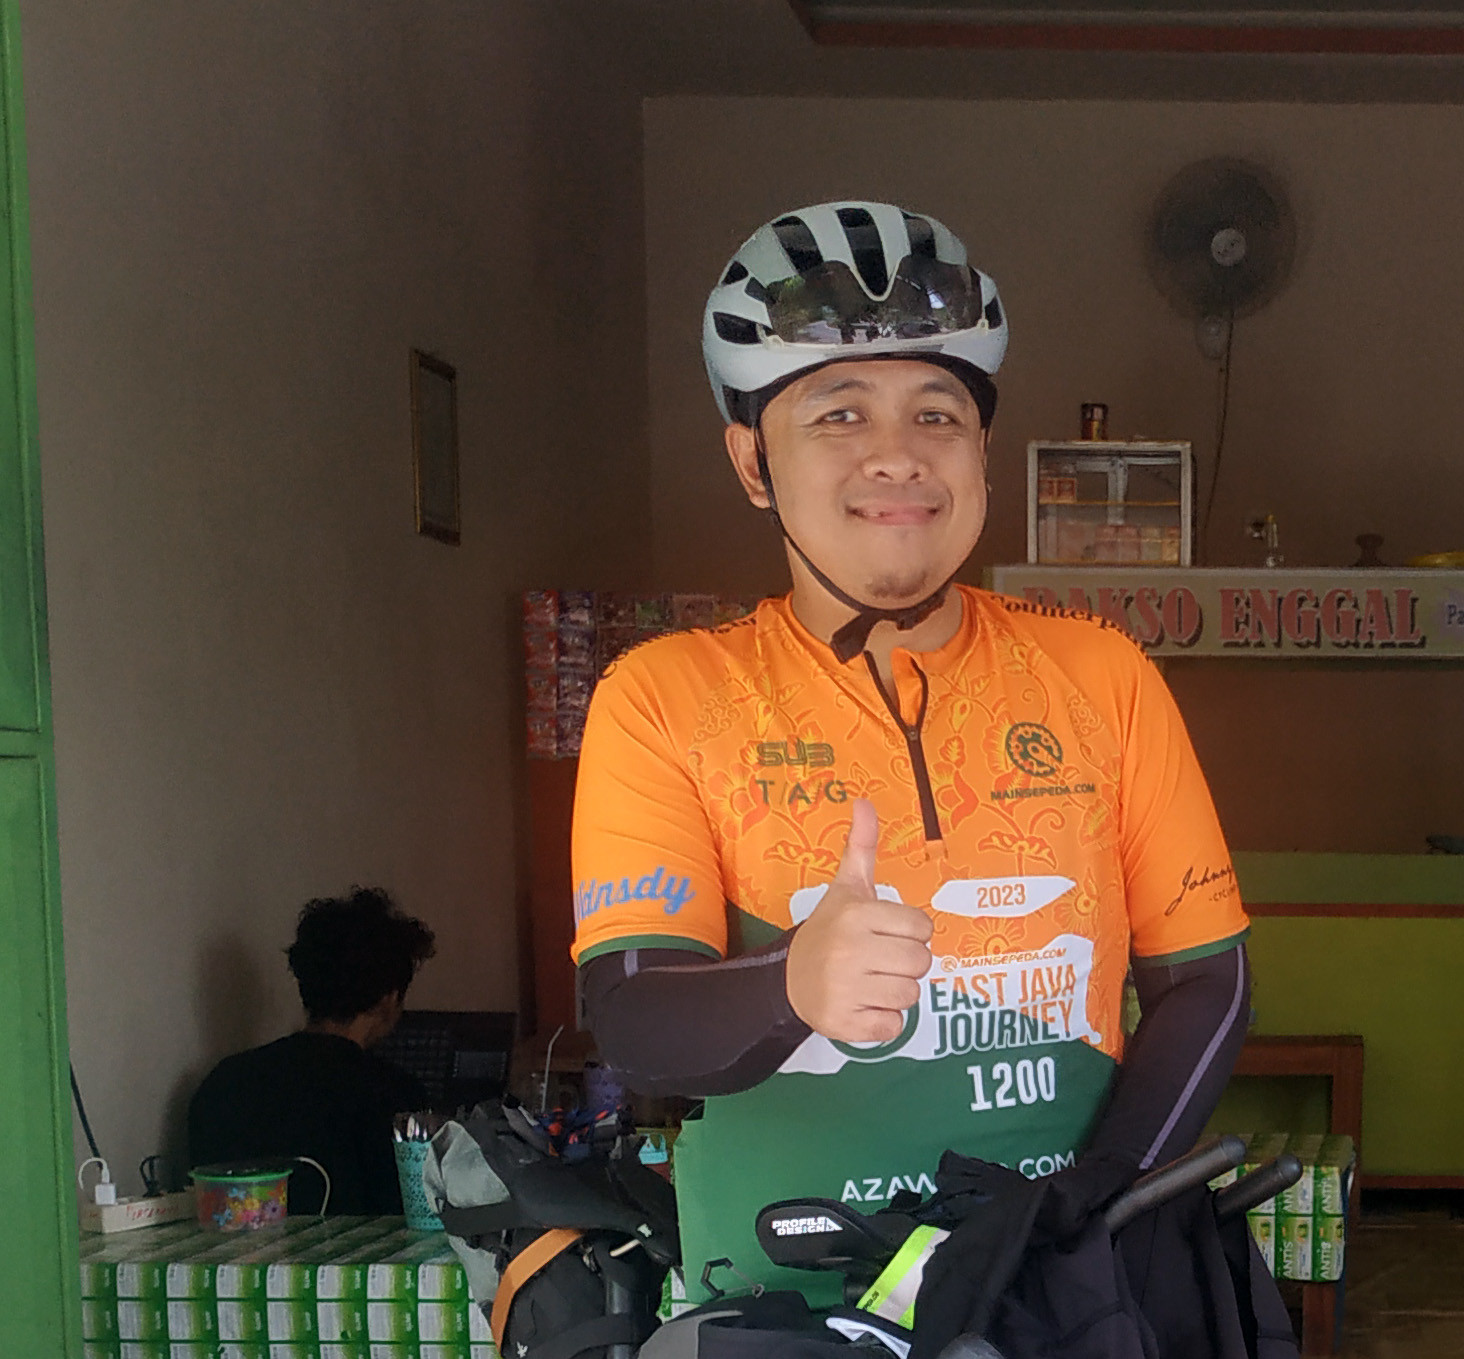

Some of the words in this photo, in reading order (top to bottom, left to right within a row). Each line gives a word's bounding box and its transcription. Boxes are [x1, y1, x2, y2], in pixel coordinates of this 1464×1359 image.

[1218, 586, 1427, 648] ENGGAL
[990, 783, 1096, 801] MAINSEPEDA.COM
[977, 883, 1026, 909] 2023
[961, 947, 1067, 968] MAINSEPEDA.COM
[929, 972, 1008, 1013] EAST
[1018, 963, 1077, 1004] JAVA
[933, 998, 1074, 1056] JOURNEY
[966, 1055, 1057, 1112] 1200
[771, 1216, 827, 1230] PROFILE
[776, 1224, 826, 1237] DESIGN
